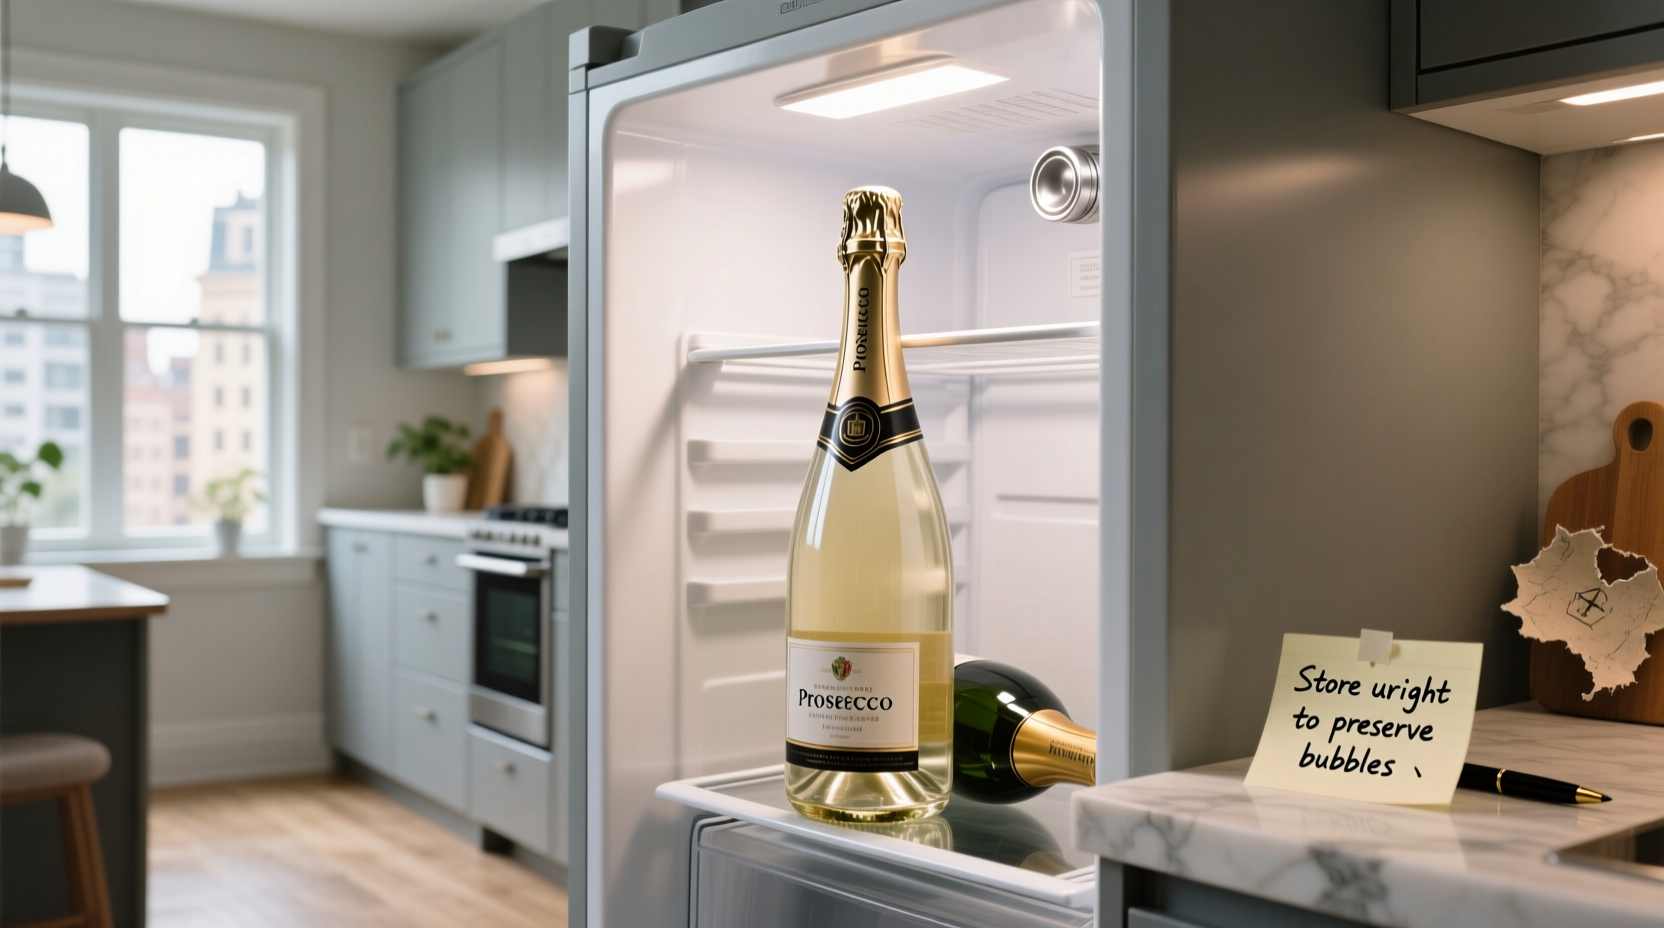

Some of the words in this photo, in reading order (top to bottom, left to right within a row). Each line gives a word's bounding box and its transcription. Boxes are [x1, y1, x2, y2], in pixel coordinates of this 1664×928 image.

[1294, 665, 1361, 696] Store
[1372, 676, 1451, 714] uright
[1293, 706, 1319, 730] to
[1328, 717, 1434, 744] preserve
[1299, 742, 1395, 777] bubbles
